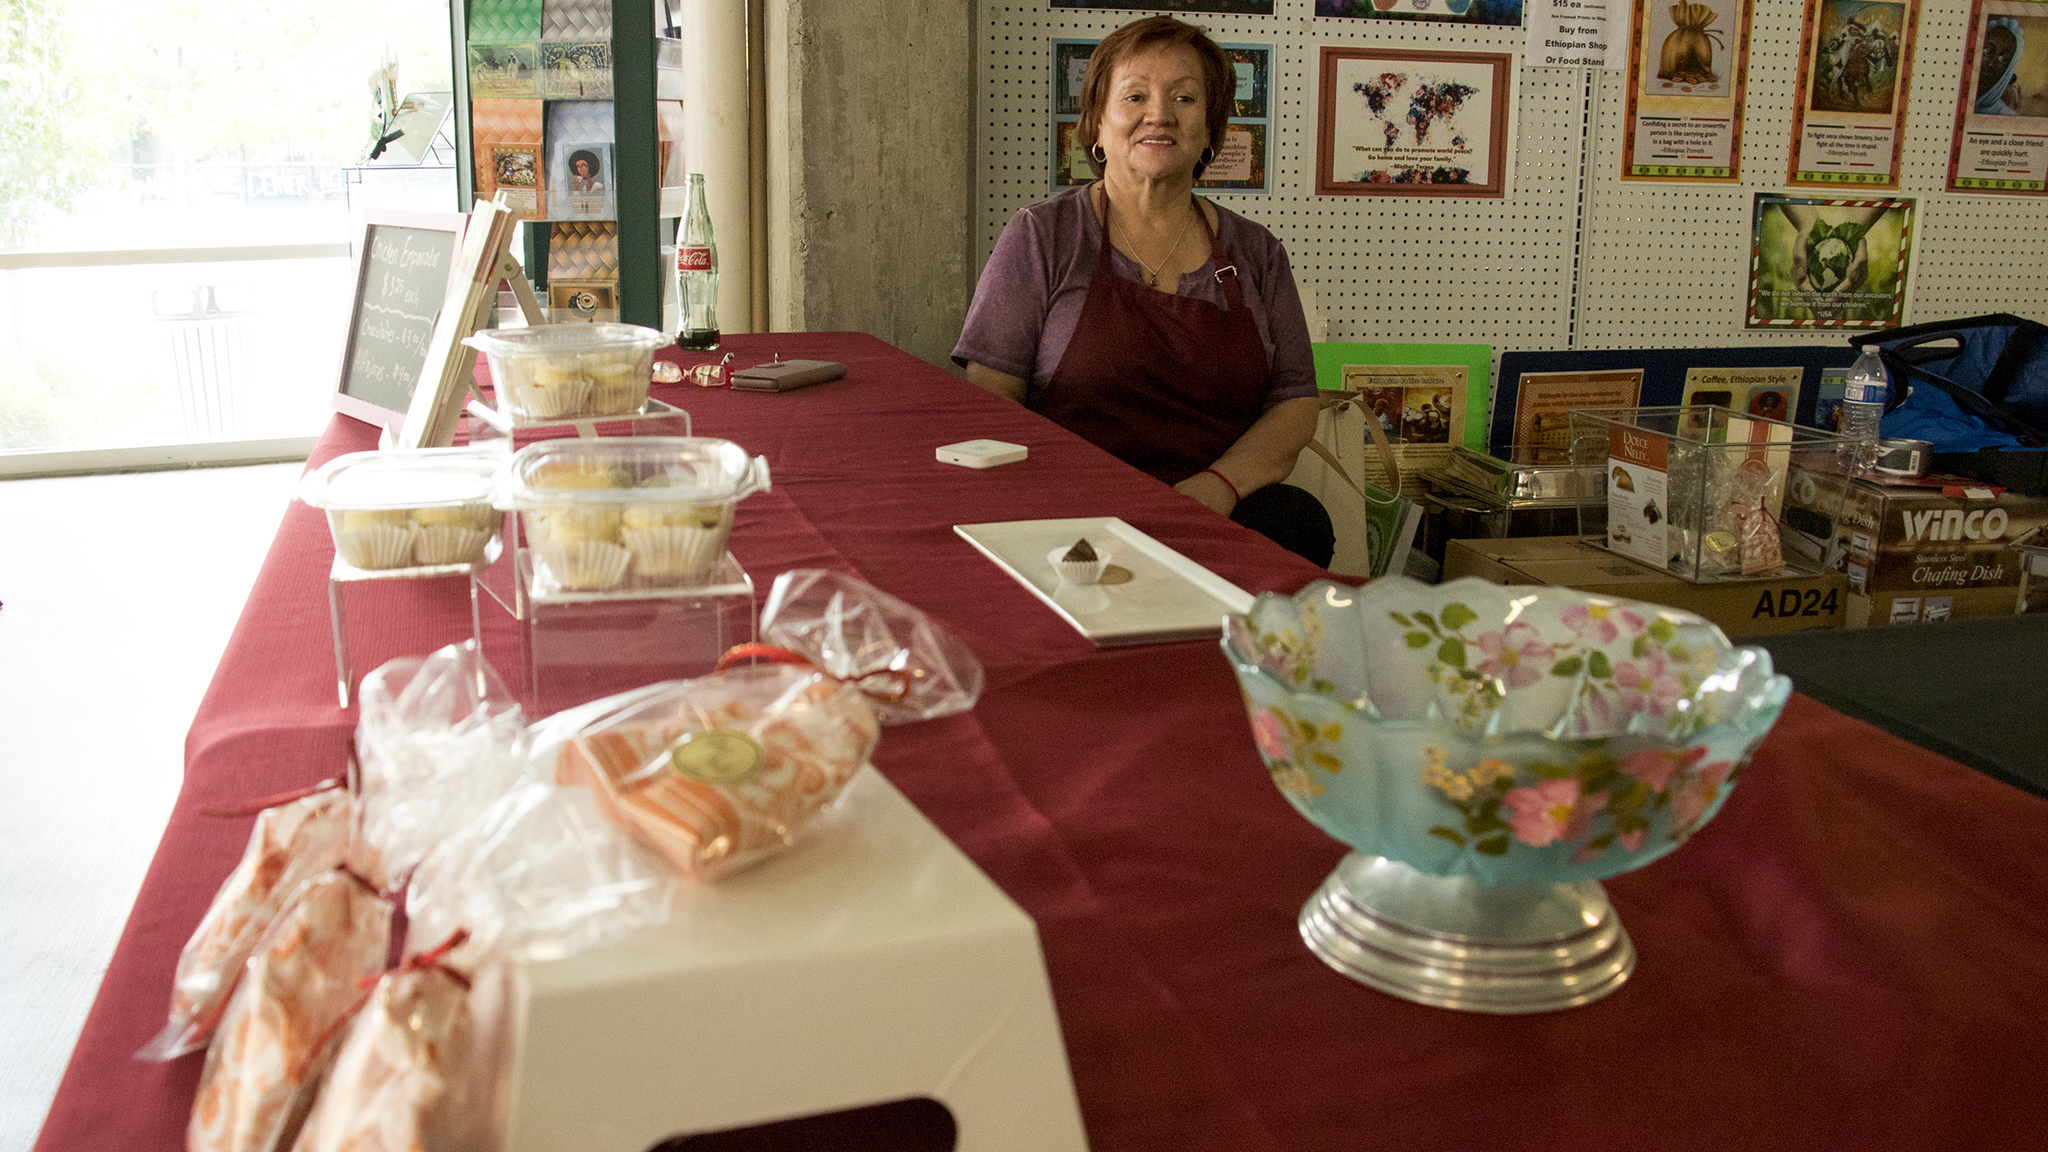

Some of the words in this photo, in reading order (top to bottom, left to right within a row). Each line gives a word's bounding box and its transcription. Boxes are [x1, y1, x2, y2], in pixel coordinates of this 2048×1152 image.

[1559, 26, 1575, 35] Buy
[1545, 40, 1586, 49] Ethiopian
[1589, 42, 1607, 51] Shop
[1559, 57, 1580, 65] Food
[1582, 58, 1604, 66] Stand
[372, 236, 398, 265] Chicken
[405, 287, 419, 307] each
[1367, 377, 1398, 385] Ethiopian
[1702, 375, 1728, 384] Coffee,
[1730, 375, 1766, 384] Ethiopian
[1768, 375, 1786, 384] Style
[1852, 512, 1874, 529] Dish
[1915, 554, 1947, 563] Stainless
[1948, 554, 1967, 562] Steel
[1912, 566, 1968, 586] Chafing
[1971, 564, 2003, 580] Dish
[1752, 588, 1838, 619] AD24
